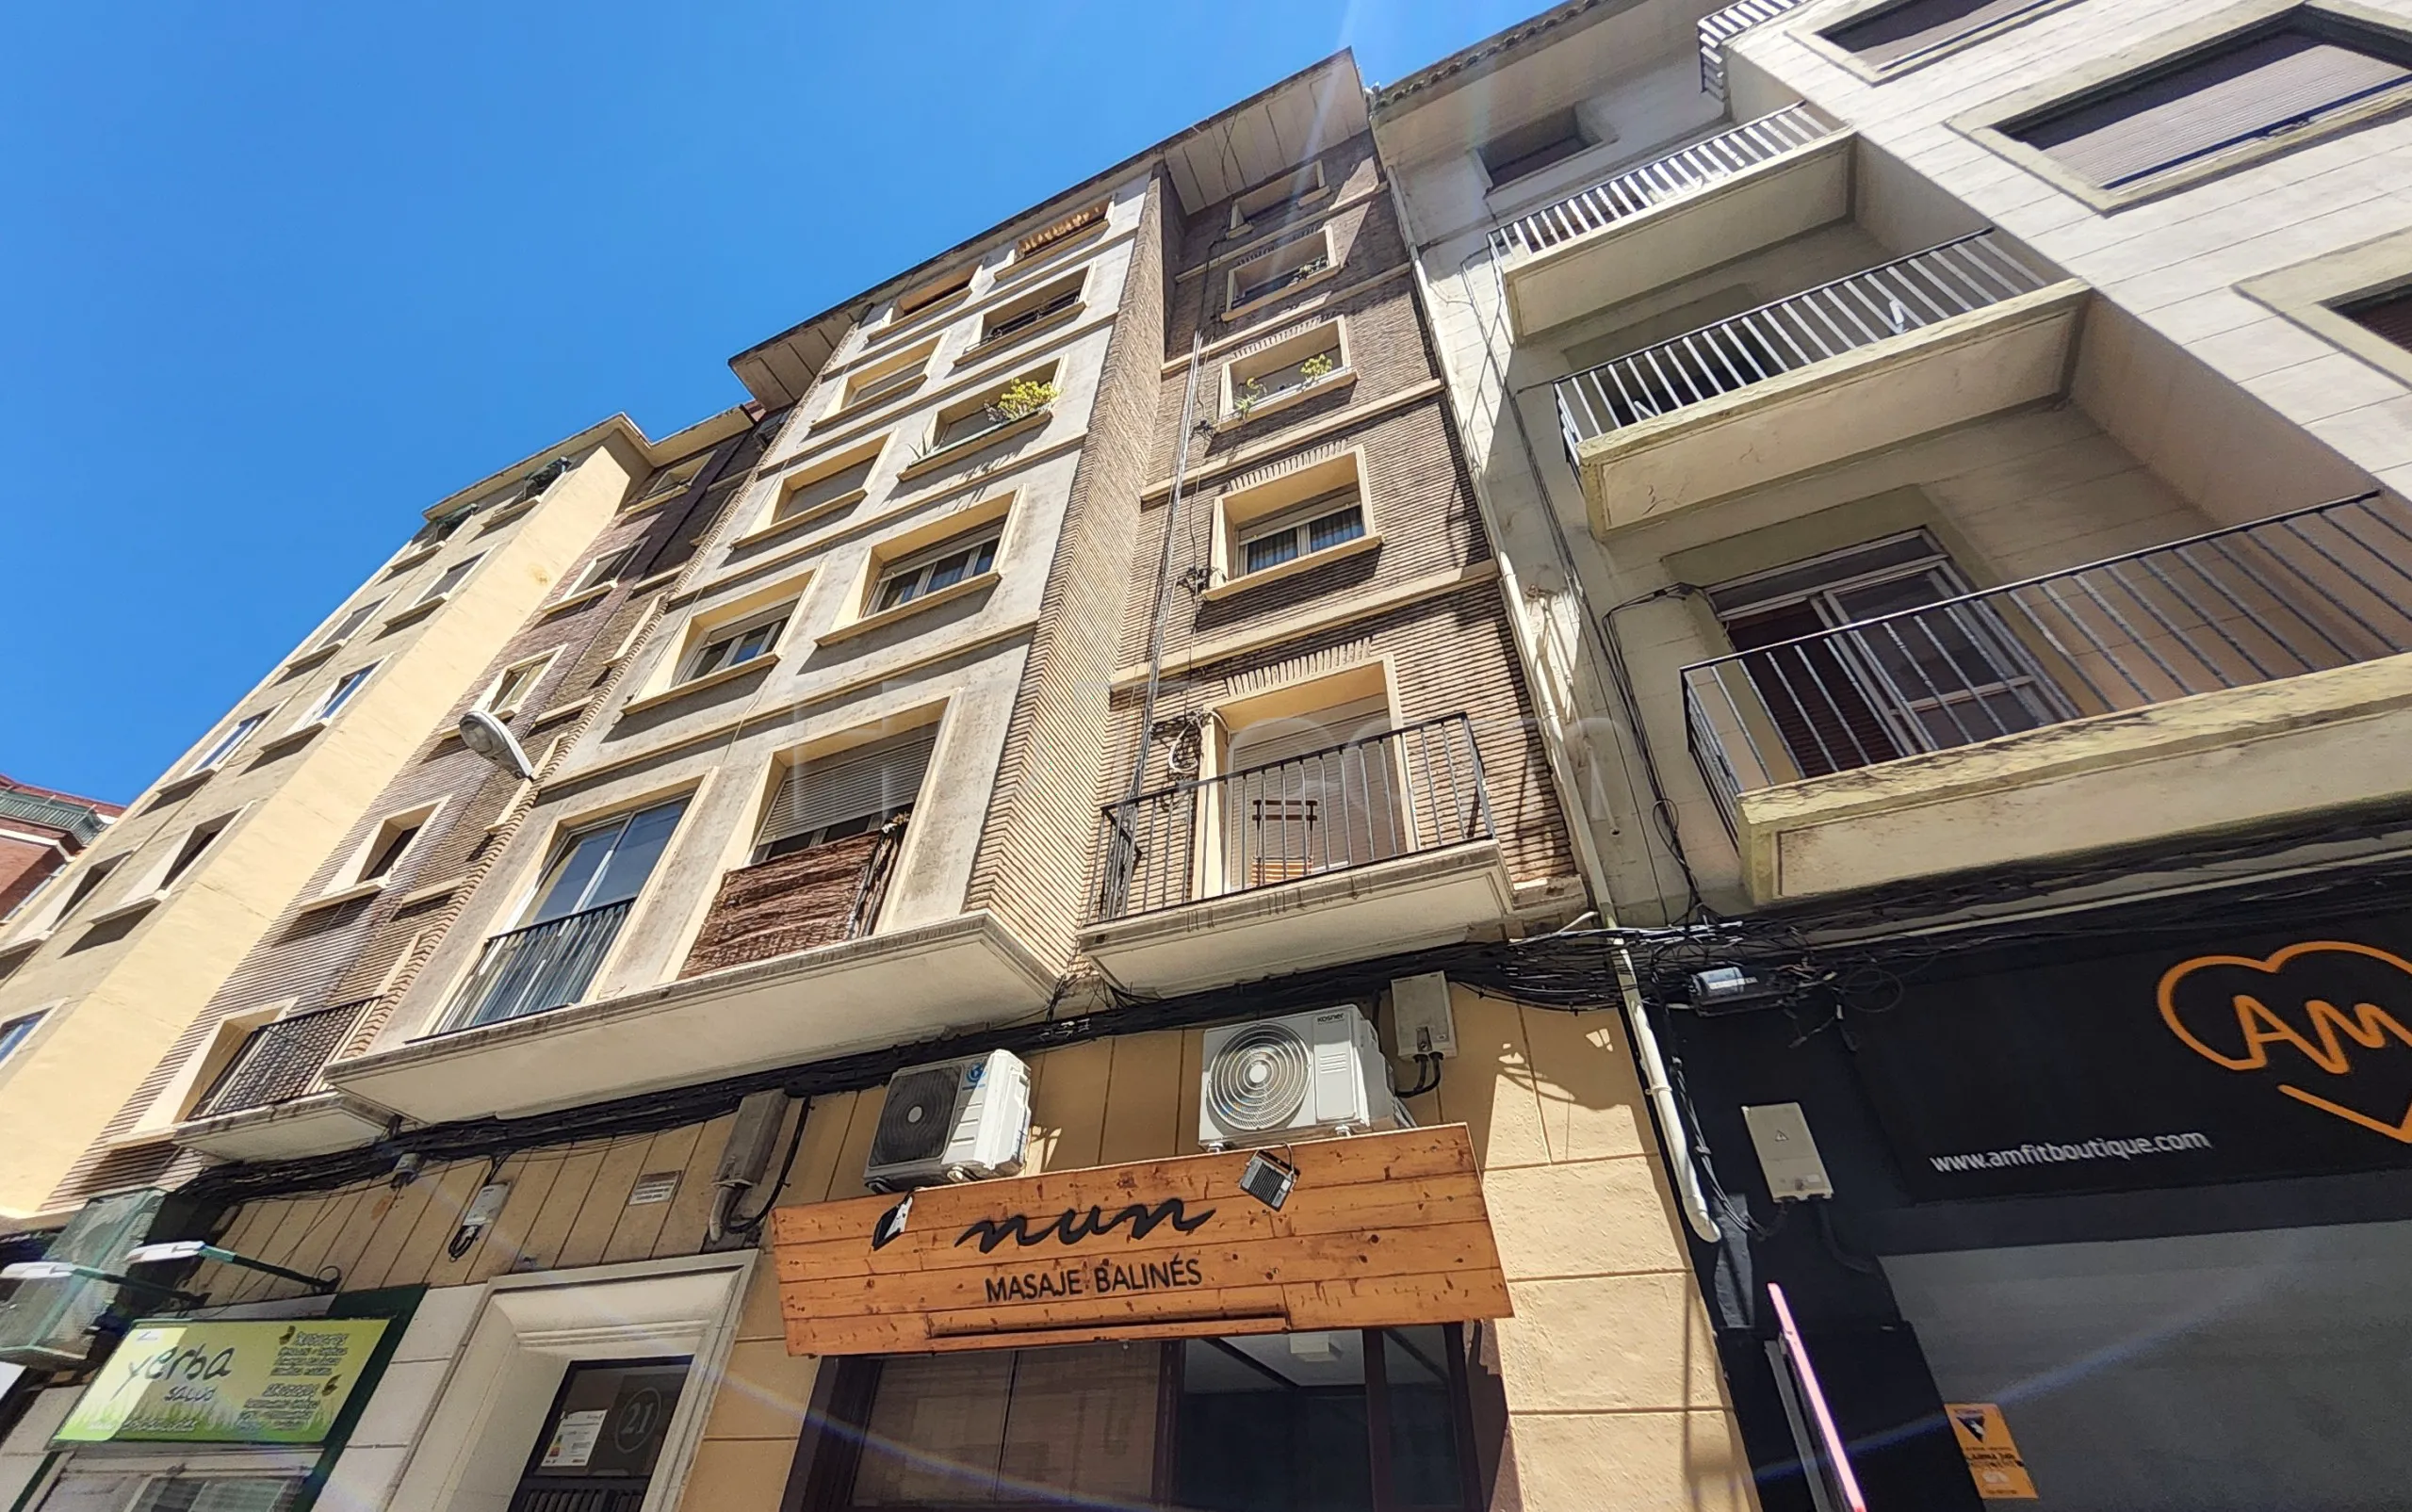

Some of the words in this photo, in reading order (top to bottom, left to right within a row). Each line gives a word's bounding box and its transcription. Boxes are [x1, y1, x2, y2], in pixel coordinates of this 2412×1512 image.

[1930, 1131, 2211, 1173] www.amfitboutique.com
[985, 1269, 1082, 1304] MASAJE
[1095, 1253, 1203, 1293] BALINÉS
[620, 1401, 655, 1435] 21
